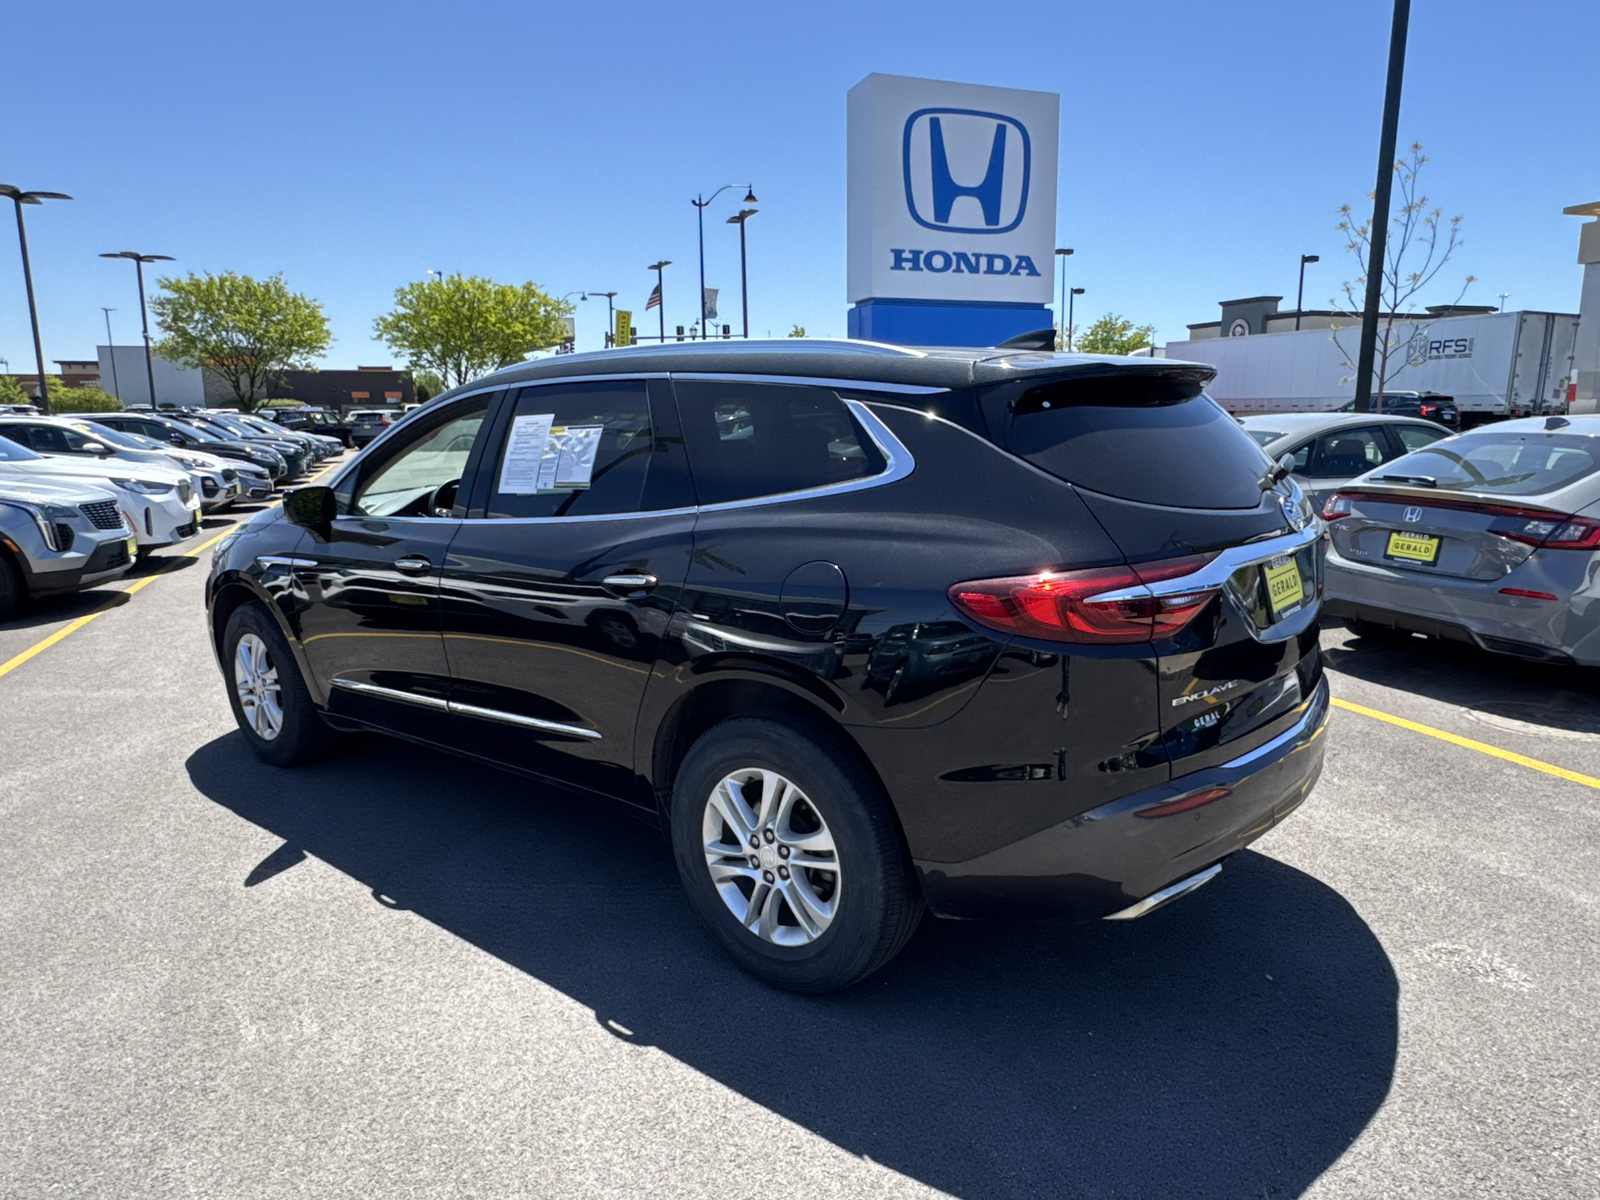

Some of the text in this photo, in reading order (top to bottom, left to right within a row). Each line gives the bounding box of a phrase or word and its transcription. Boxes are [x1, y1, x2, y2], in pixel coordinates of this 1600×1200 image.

[890, 248, 1041, 277] HONDA
[1428, 338, 1468, 354] RFS
[1400, 531, 1430, 540] GERALD
[1394, 542, 1430, 554] GERALD
[1271, 574, 1298, 596] GERALD
[1172, 679, 1239, 706] ENCLAVE
